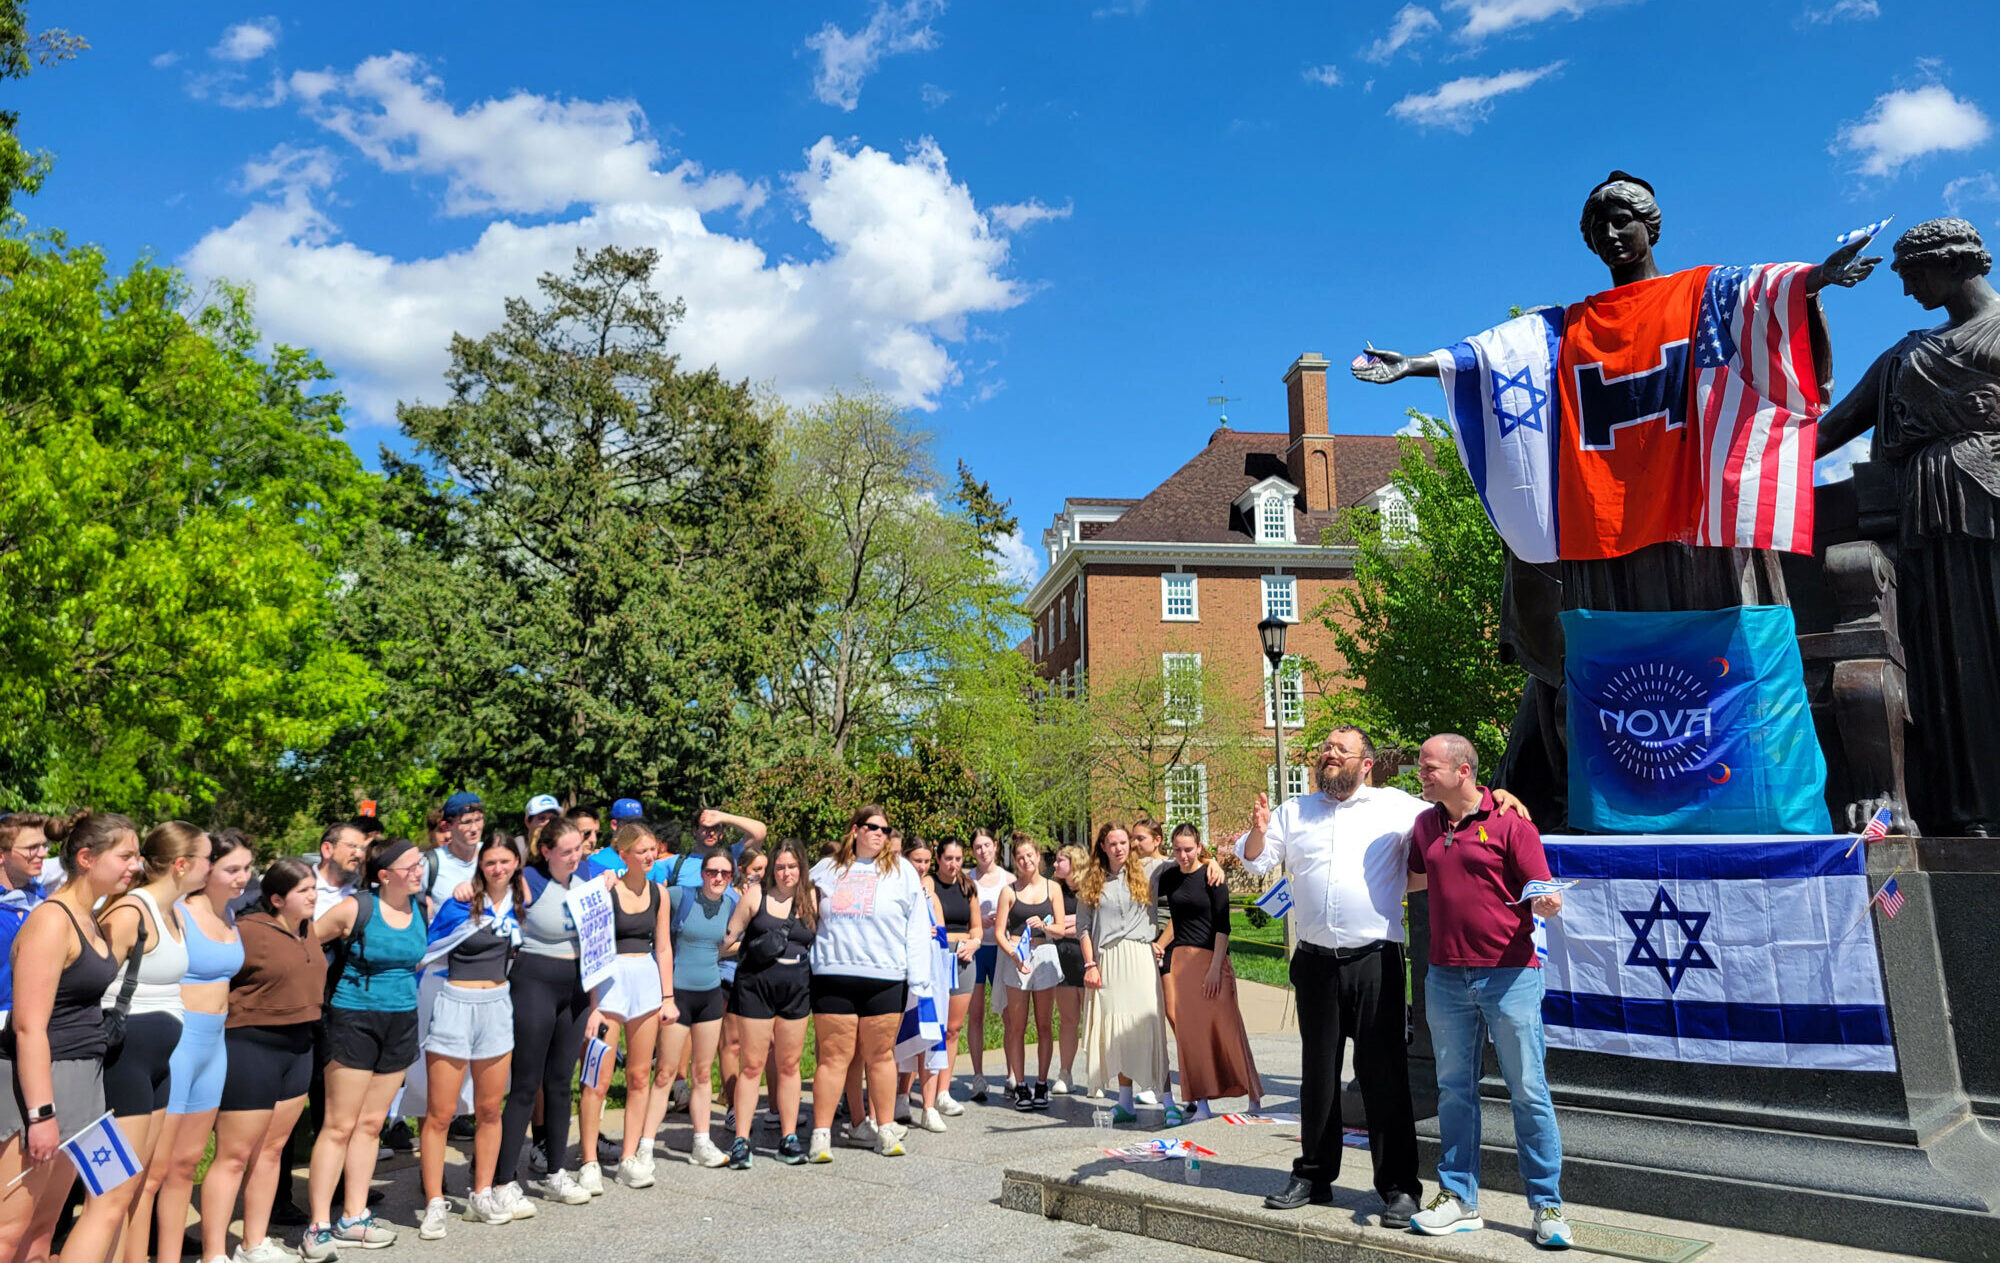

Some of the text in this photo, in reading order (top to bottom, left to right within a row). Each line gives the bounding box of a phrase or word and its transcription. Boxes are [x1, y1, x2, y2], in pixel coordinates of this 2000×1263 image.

[1600, 708, 1712, 737] NOVA
[579, 890, 603, 911] FREE
[580, 912, 612, 941] SUPPORT
